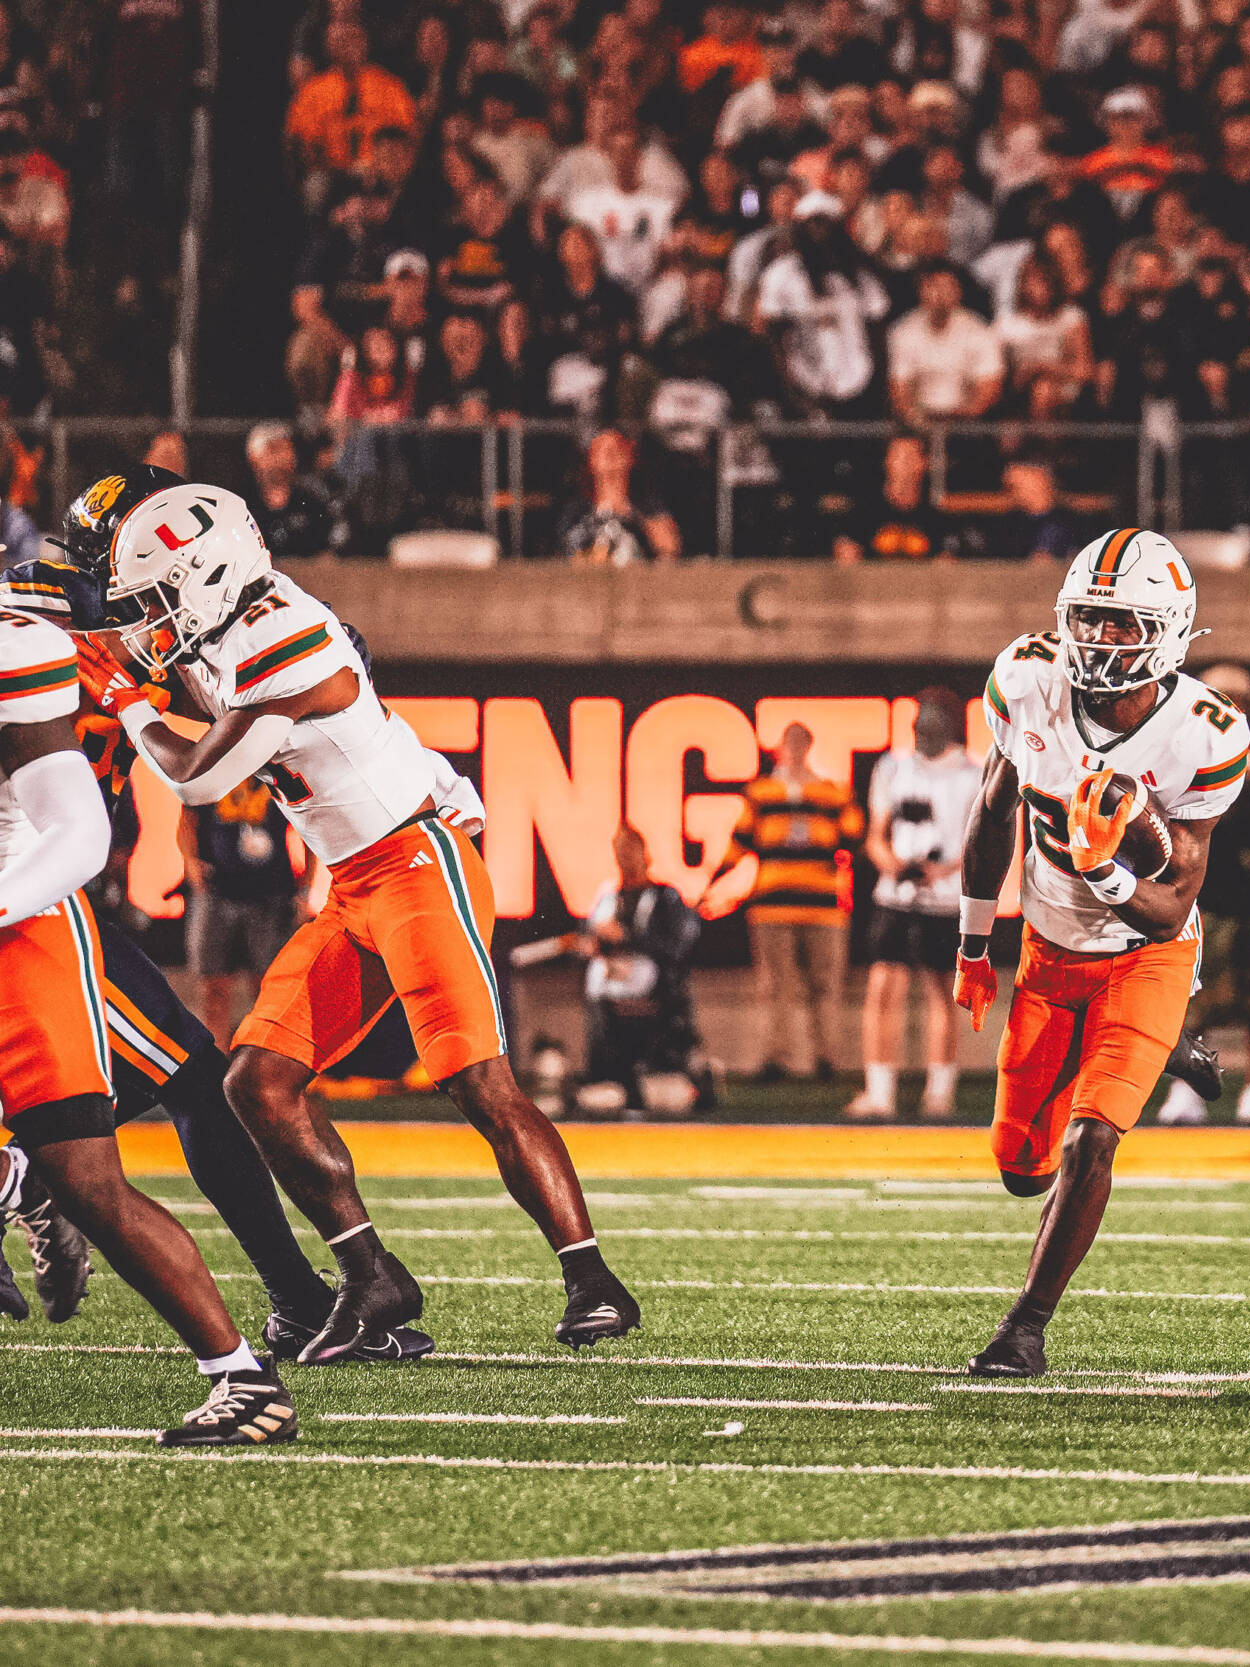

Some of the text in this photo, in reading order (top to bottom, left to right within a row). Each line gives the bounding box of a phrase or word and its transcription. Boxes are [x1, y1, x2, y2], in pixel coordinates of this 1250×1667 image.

[154, 503, 214, 551] U
[1086, 588, 1115, 598] MIAMI
[1020, 783, 1083, 880] 2
